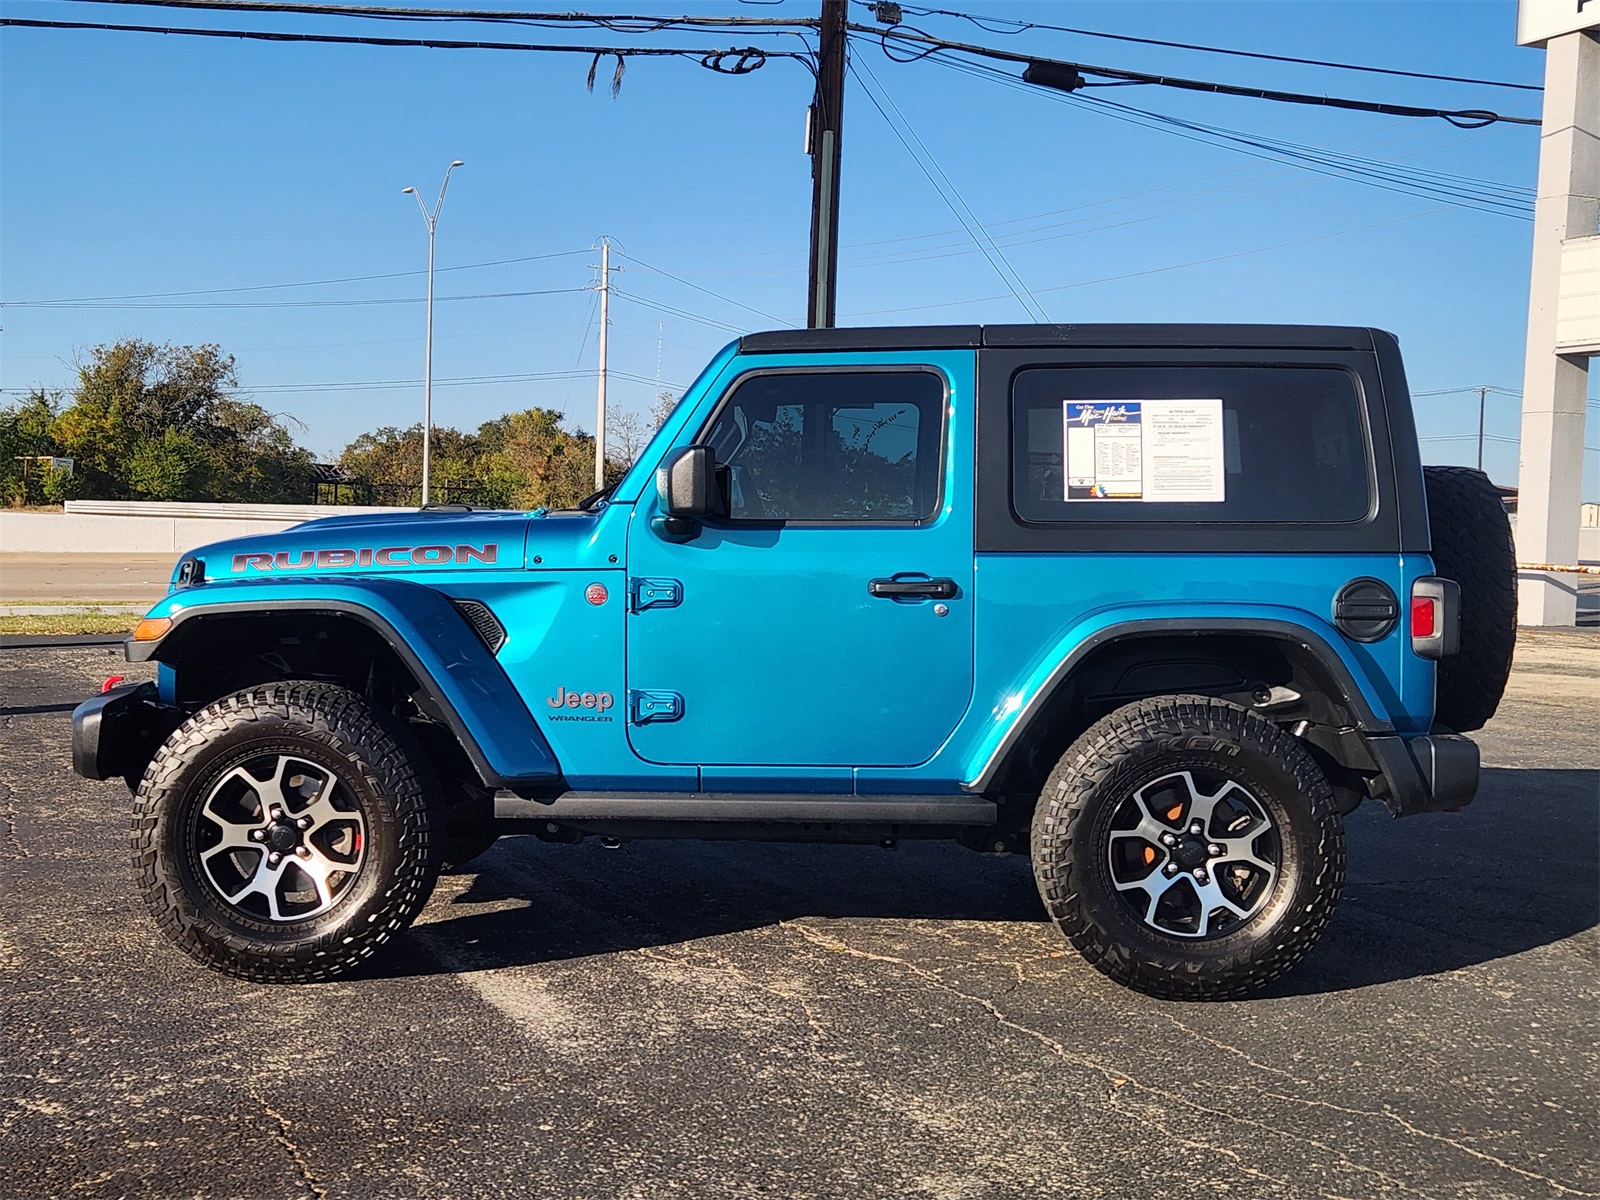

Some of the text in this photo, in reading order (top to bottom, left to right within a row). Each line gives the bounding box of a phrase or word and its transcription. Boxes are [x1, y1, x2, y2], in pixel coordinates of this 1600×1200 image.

[231, 544, 499, 573] RUBICON
[547, 686, 614, 713] Jeep
[547, 714, 613, 723] WRANGLER
